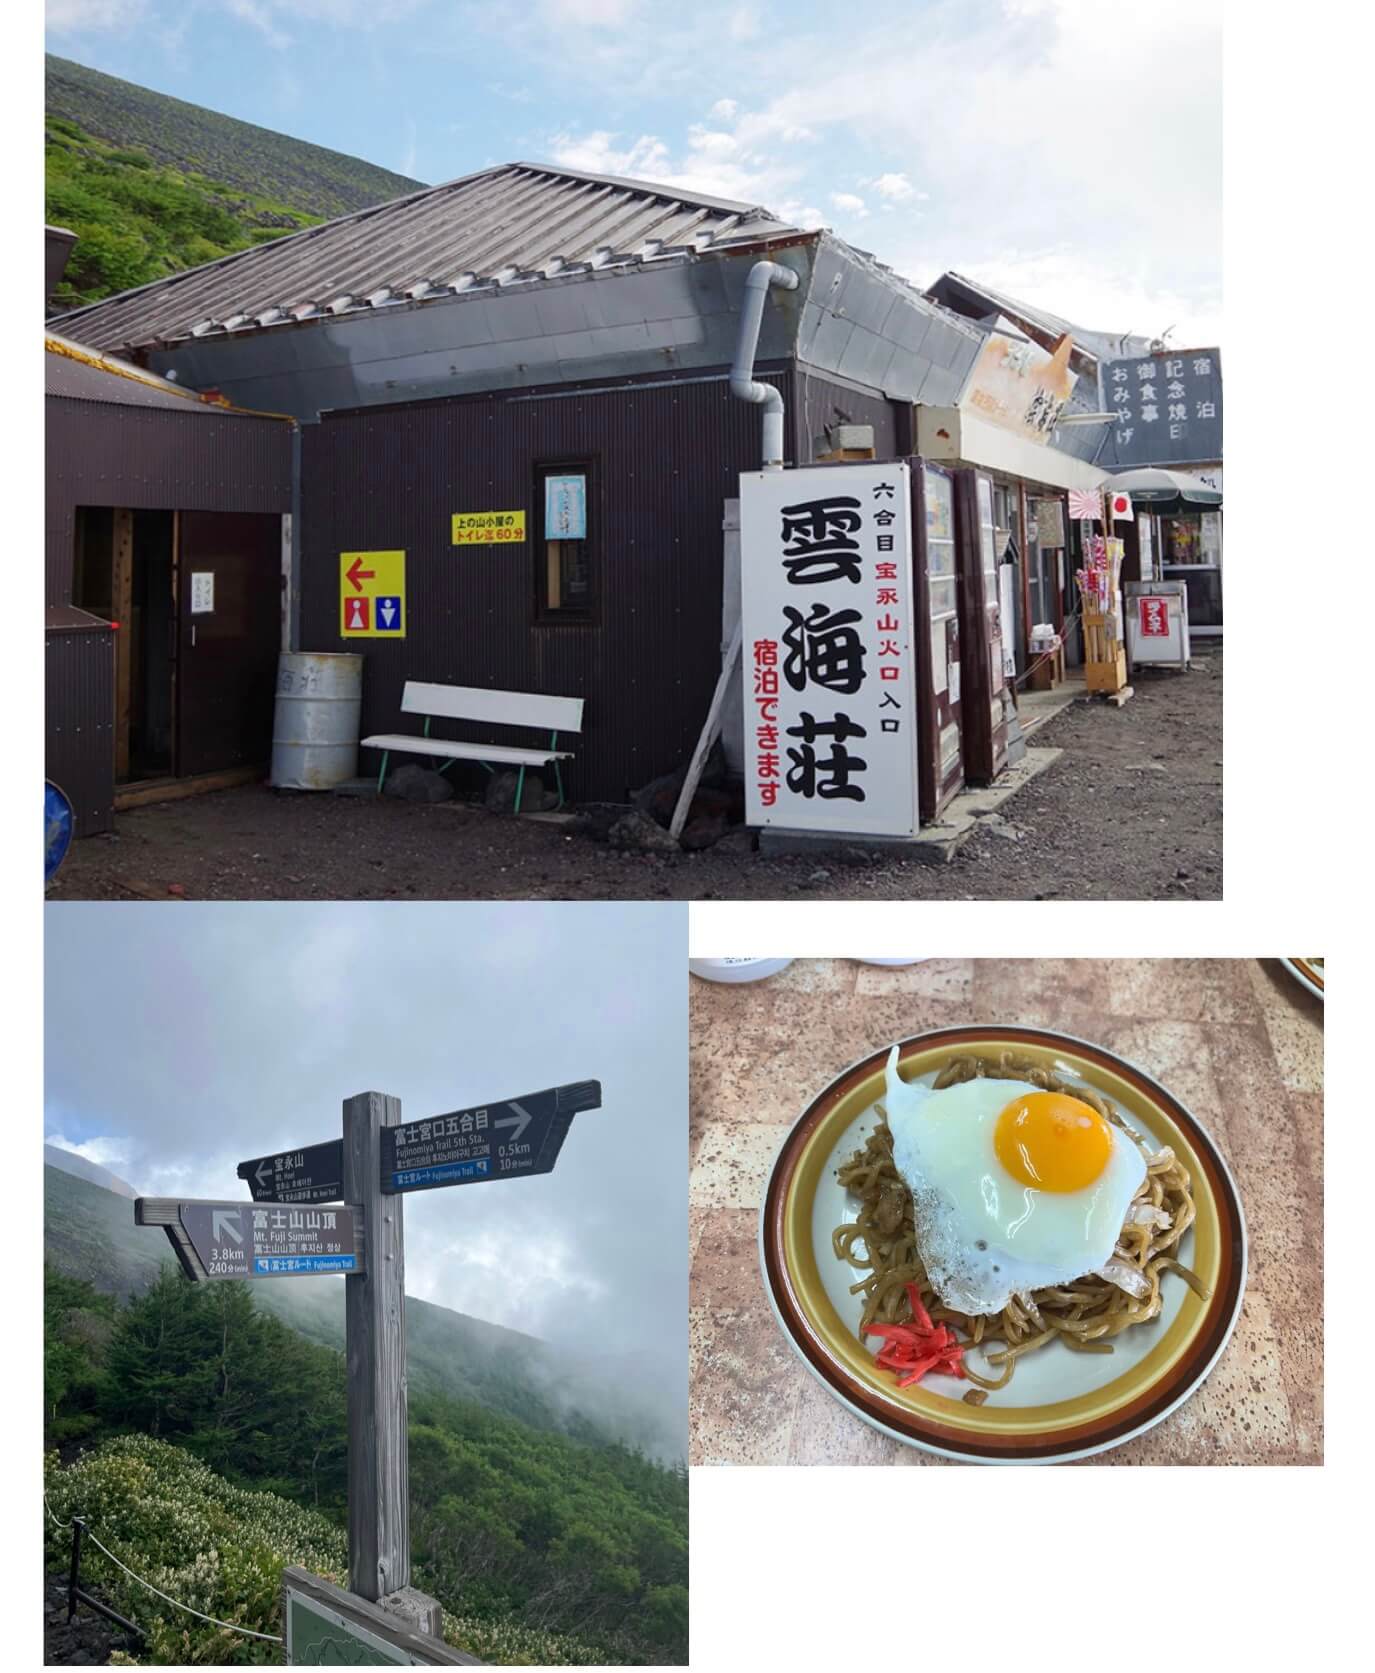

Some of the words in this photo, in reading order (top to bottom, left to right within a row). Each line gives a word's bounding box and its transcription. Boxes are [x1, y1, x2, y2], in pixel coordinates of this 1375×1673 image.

[1137, 362, 1159, 423] 御食事
[1112, 368, 1135, 445] おみやげ
[457, 515, 514, 529] 上の山小屋の
[780, 495, 868, 803] 雲海荘
[753, 638, 780, 808] 宿泊できます
[394, 1109, 489, 1147] 富士宮口五合目
[396, 1143, 434, 1159] Fujinomiya
[435, 1136, 451, 1149] Trail
[453, 1134, 468, 1148] 5th
[469, 1133, 485, 1145] Sta.
[498, 1143, 530, 1157] 0.5km
[274, 1152, 304, 1172] 宝永山
[252, 1210, 338, 1230] 富士山山頂
[253, 1232, 268, 1241] Mt.
[270, 1231, 286, 1243] Fuji
[288, 1231, 318, 1241] Summit
[211, 1247, 244, 1260] 3.8km
